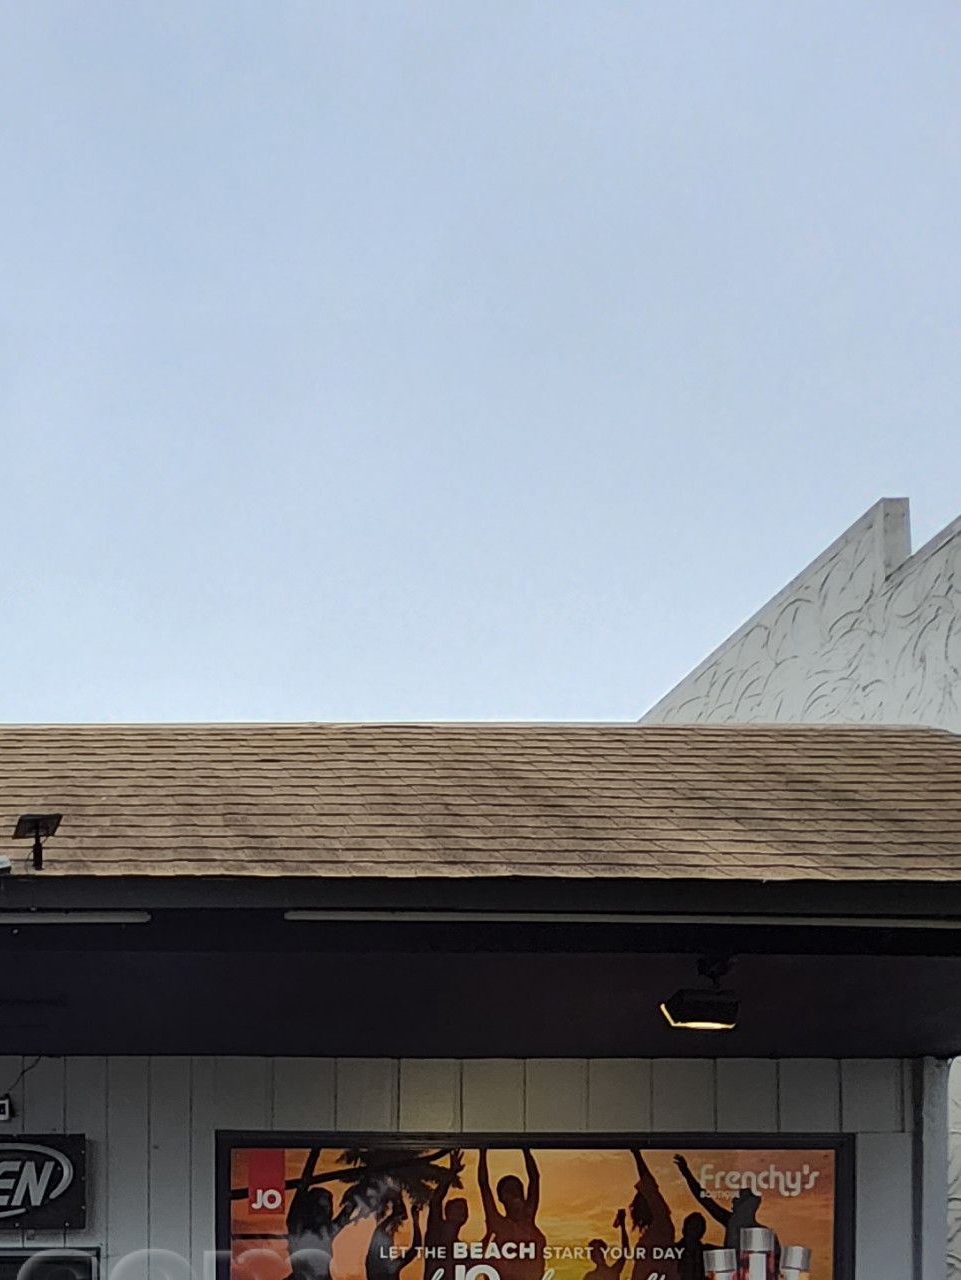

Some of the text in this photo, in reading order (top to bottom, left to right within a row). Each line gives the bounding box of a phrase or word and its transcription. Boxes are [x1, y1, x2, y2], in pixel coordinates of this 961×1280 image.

[700, 1163, 820, 1197] Frenchy's
[251, 1188, 282, 1210] JO
[380, 1241, 686, 1260] LET THE BEACH START YOUR DAY
